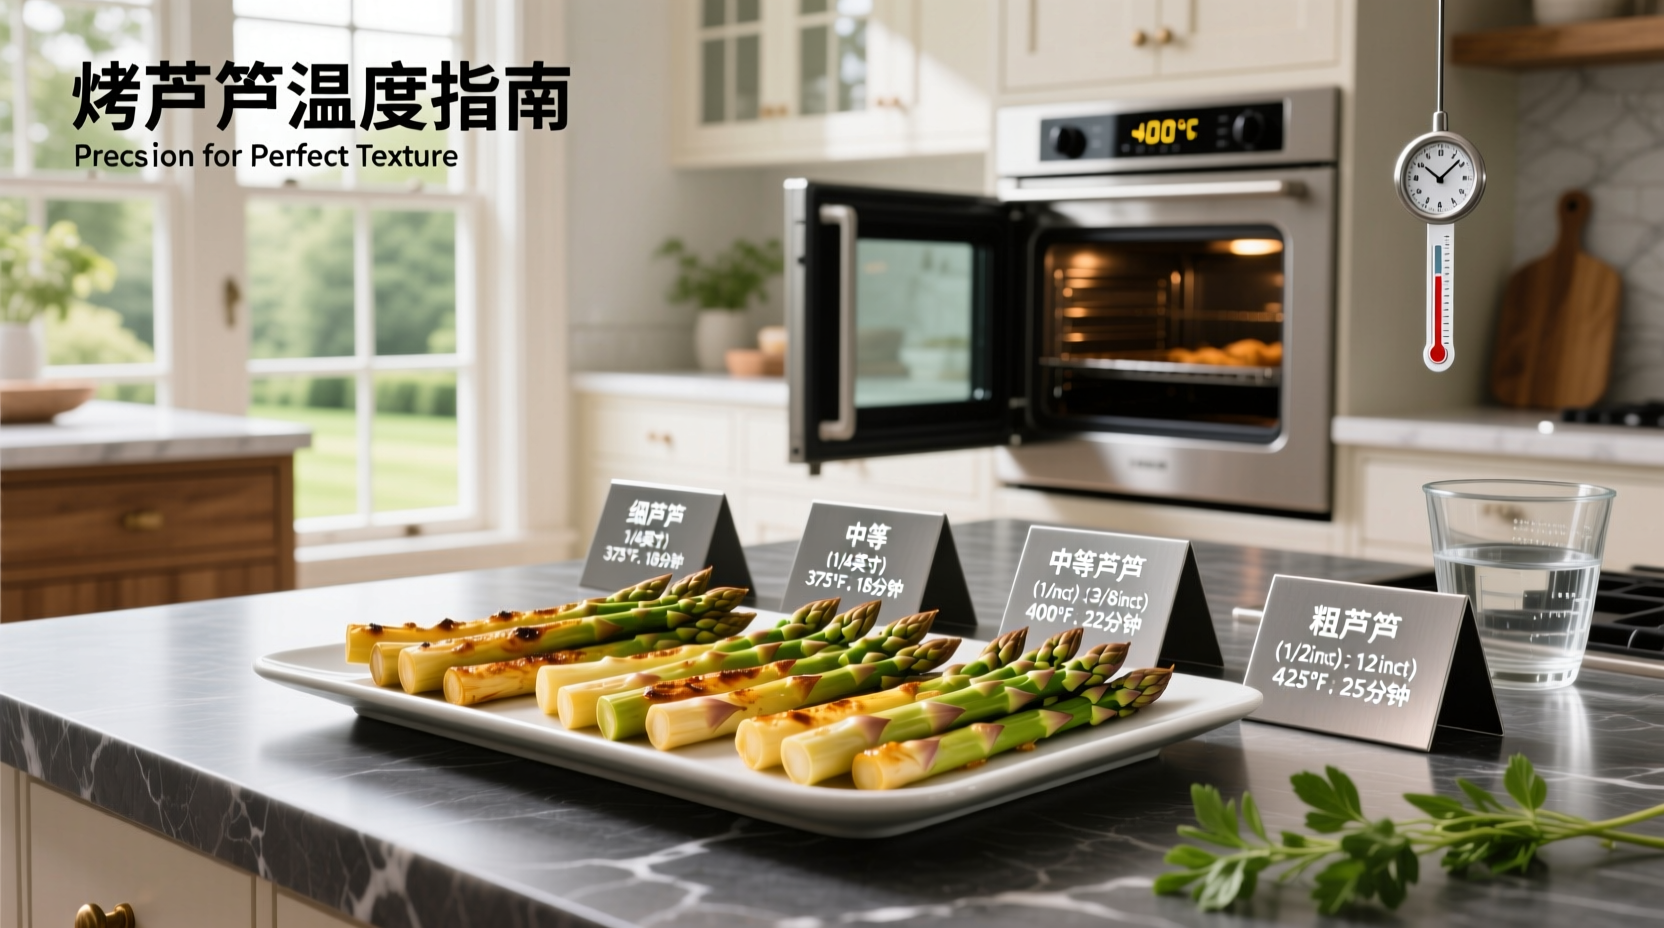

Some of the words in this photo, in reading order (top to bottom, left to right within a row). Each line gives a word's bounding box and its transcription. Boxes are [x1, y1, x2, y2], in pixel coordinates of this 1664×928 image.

[846, 521, 892, 550] 中等
[827, 551, 887, 576] (1/4英寸)
[1082, 610, 1142, 636] 22分钟
[1309, 605, 1403, 644] 粗芦笋
[1340, 677, 1411, 707] 25分钟
